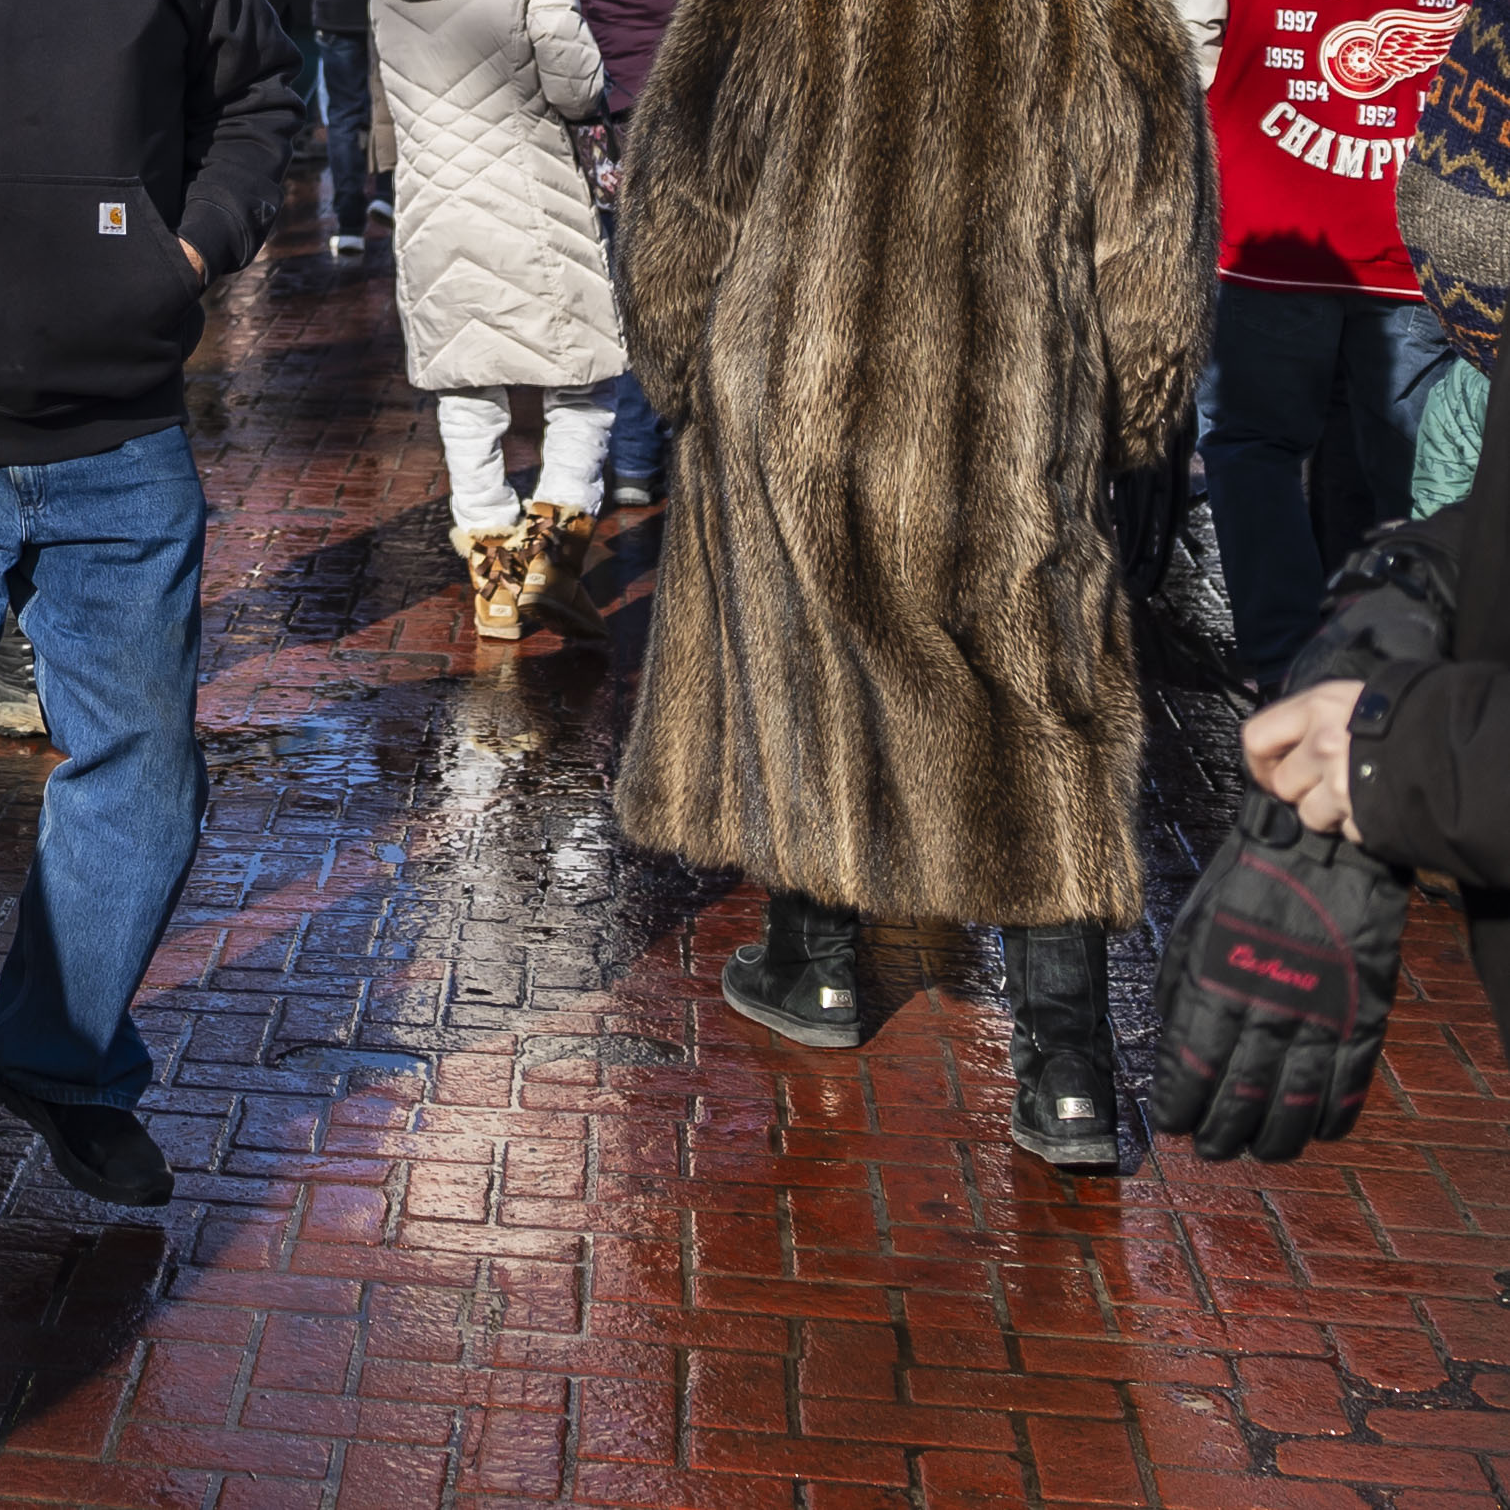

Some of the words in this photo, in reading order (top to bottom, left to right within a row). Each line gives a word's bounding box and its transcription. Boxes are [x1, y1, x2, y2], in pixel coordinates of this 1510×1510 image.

[1275, 9, 1318, 33] 1997
[1264, 47, 1305, 70] 1955
[1287, 79, 1330, 102] 1954
[1357, 104, 1397, 127] 1952
[1260, 101, 1416, 181] CHAMPI
